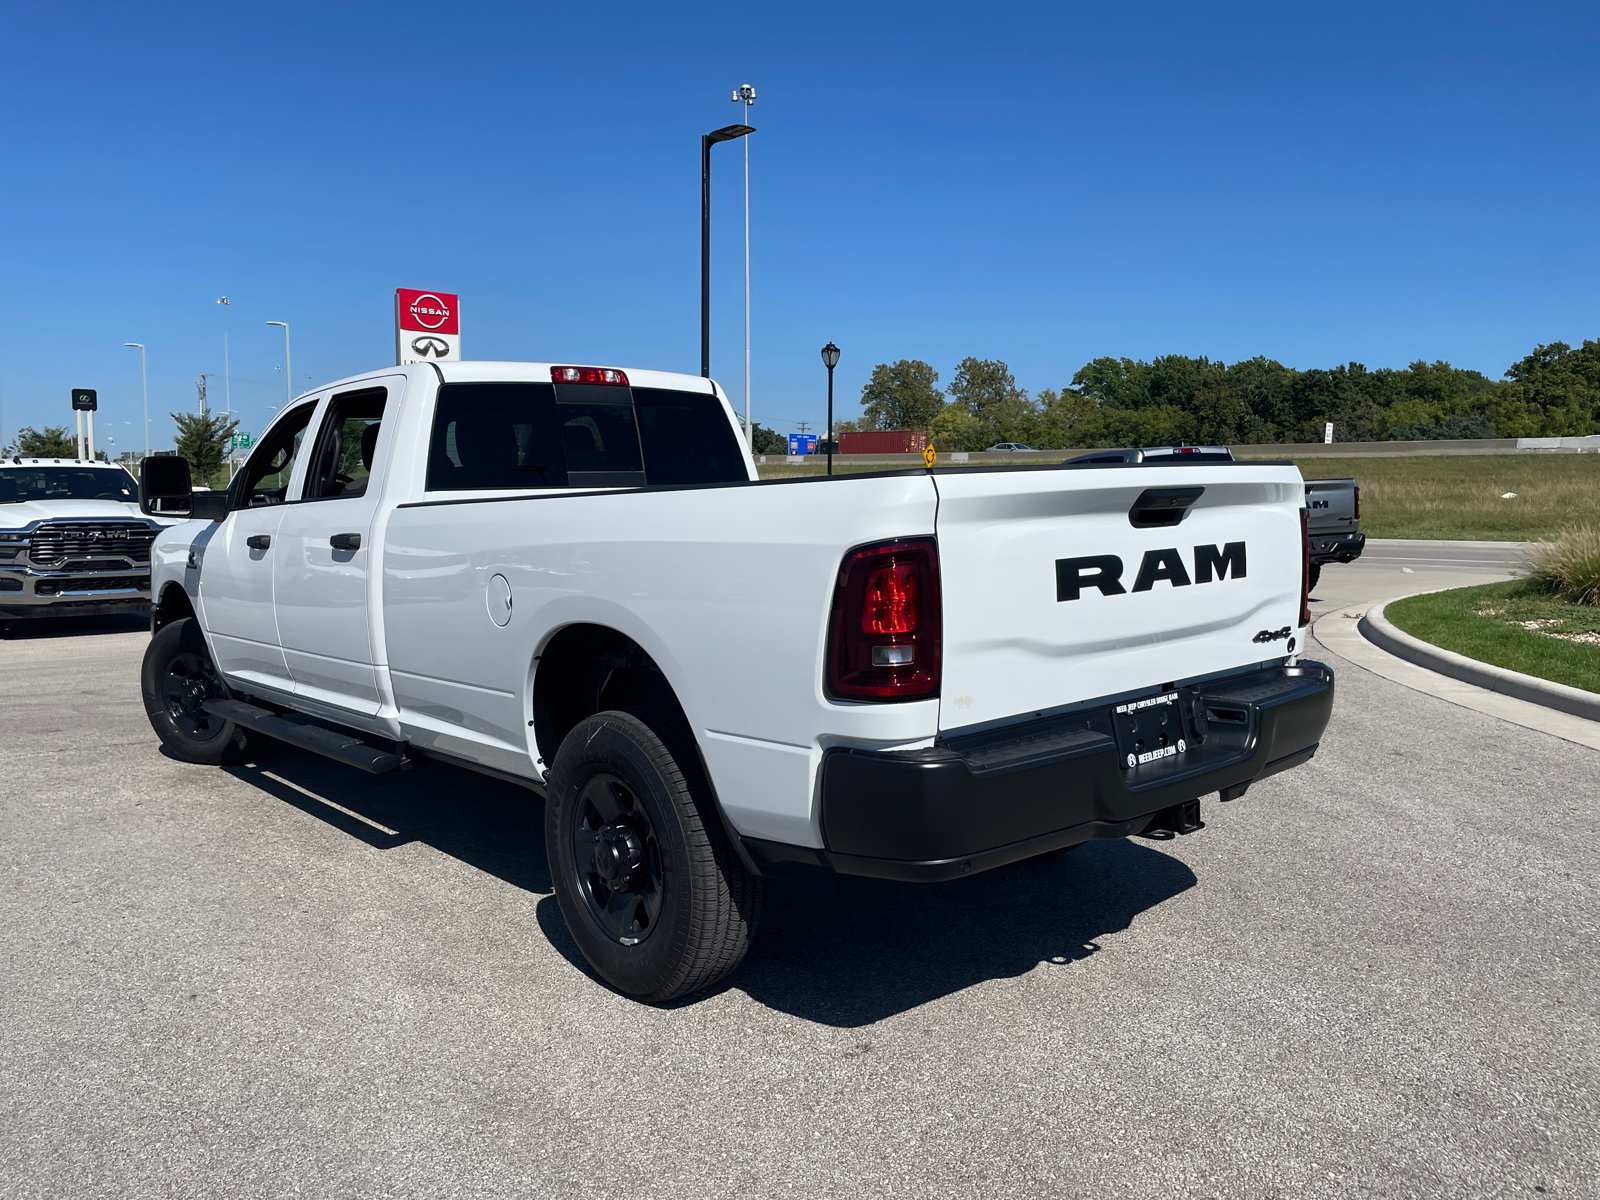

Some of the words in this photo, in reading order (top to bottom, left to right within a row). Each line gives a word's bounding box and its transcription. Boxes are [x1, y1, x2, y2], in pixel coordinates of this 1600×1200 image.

[410, 307, 449, 317] NISSAN
[64, 531, 127, 540] RAM
[1055, 541, 1247, 603] RAM
